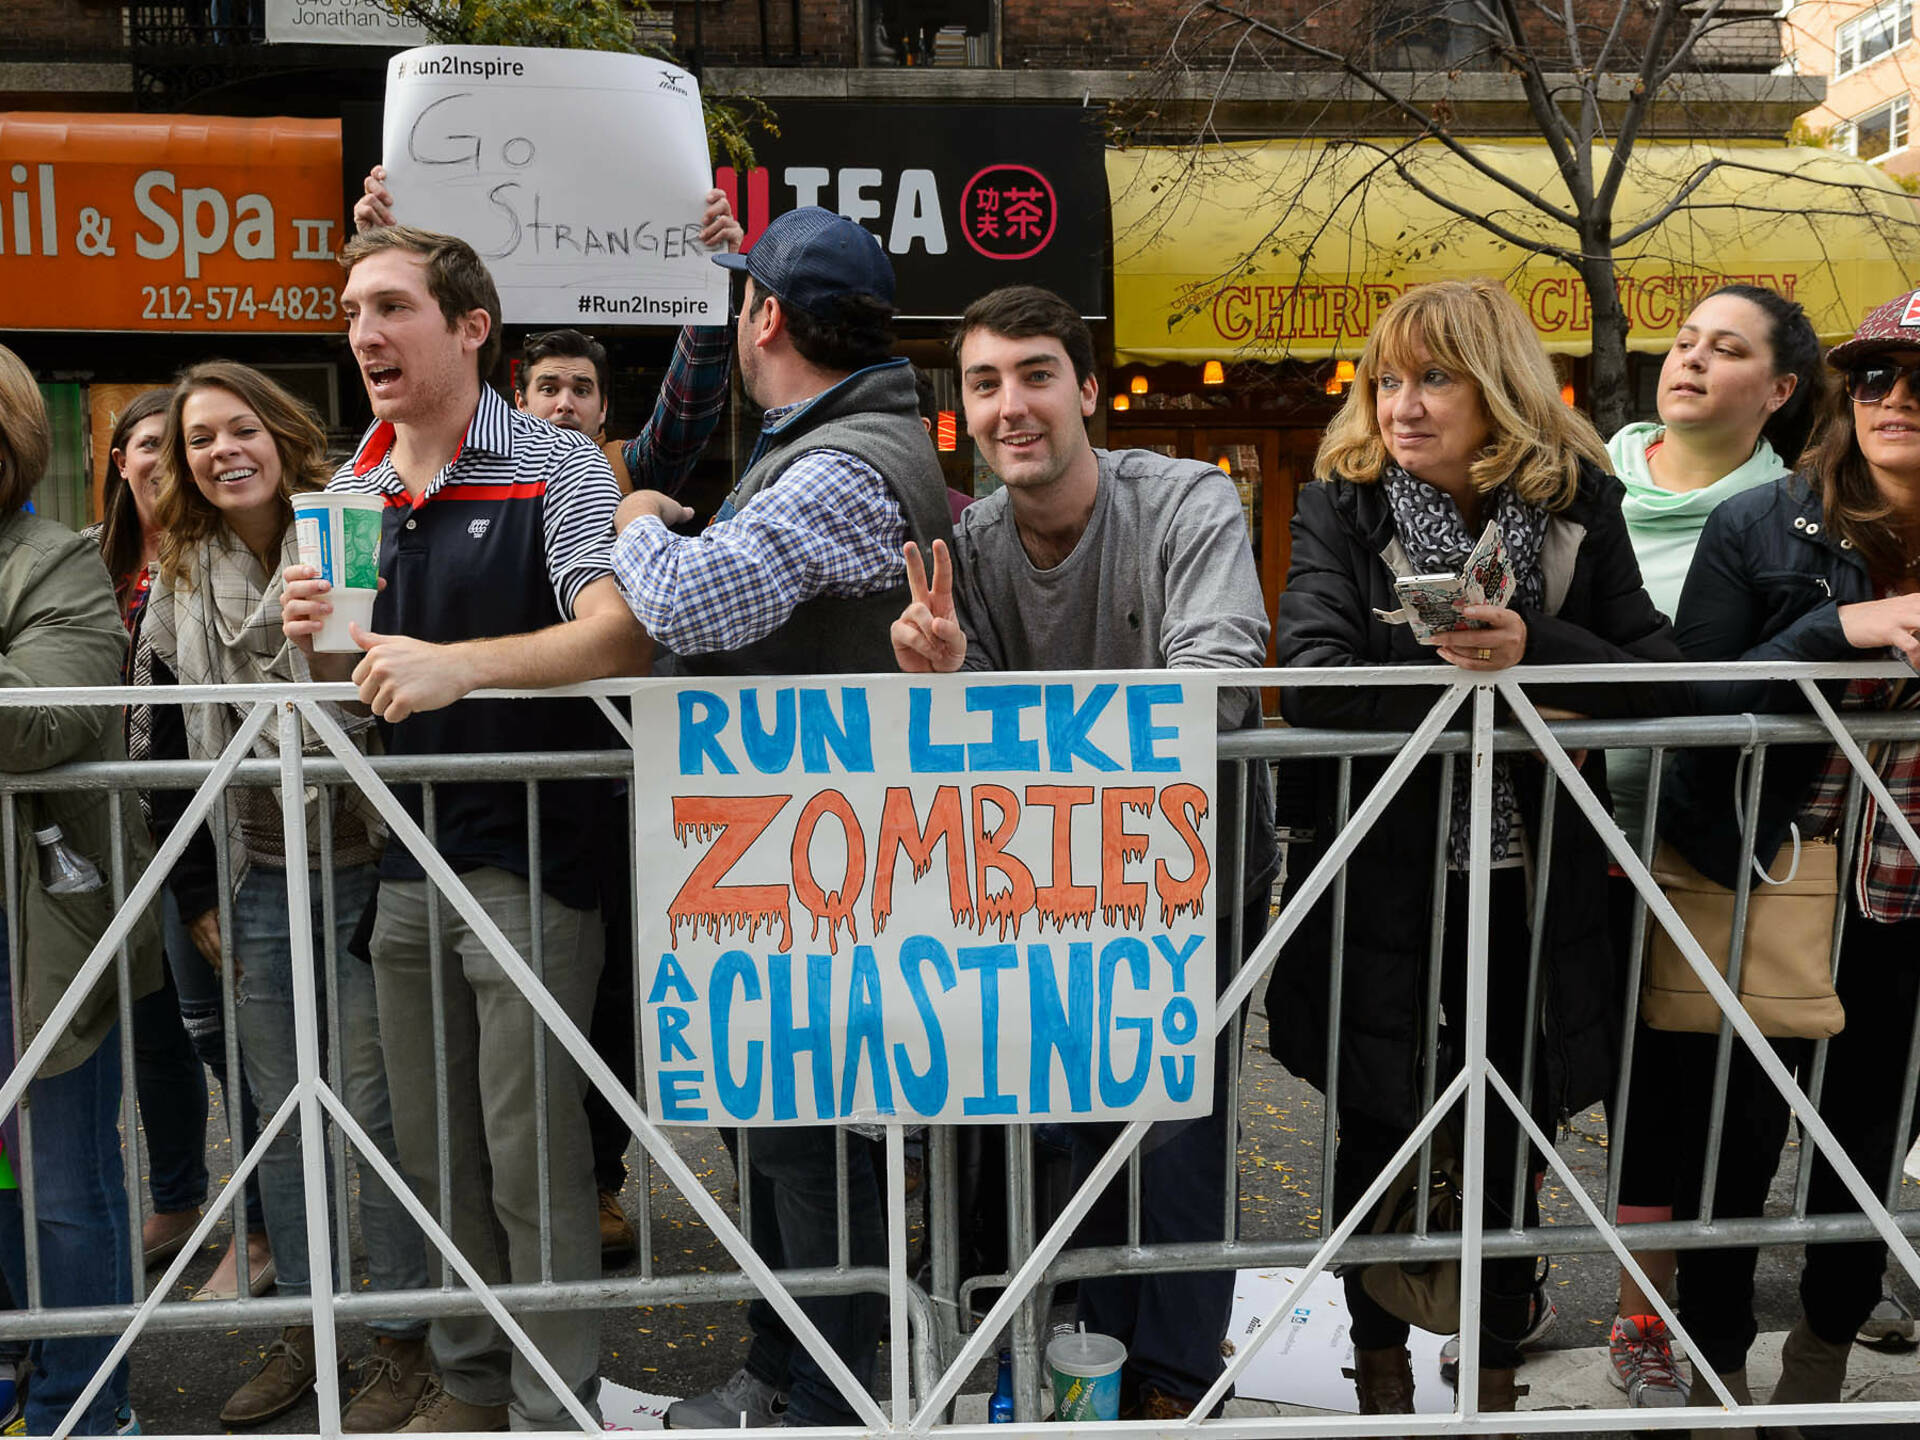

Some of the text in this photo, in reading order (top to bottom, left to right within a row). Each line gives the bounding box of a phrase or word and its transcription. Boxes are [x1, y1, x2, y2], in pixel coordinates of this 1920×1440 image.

[292, 7, 380, 27] Jonathan
[398, 55, 525, 80] #un2Inspire
[76, 207, 116, 257] &
[134, 169, 275, 279] Spa
[292, 219, 335, 259] II
[785, 167, 949, 255] TEA
[141, 286, 337, 320] 212-574-4823
[577, 296, 709, 321] #Run2Inspire
[1213, 281, 1506, 341] CHIRP
[676, 683, 1185, 776] RUN LIKE
[666, 782, 1213, 955] ZOMBIES
[647, 952, 709, 1121] ARE
[709, 934, 1154, 1121] CHASING
[1150, 934, 1207, 1103] YOU
